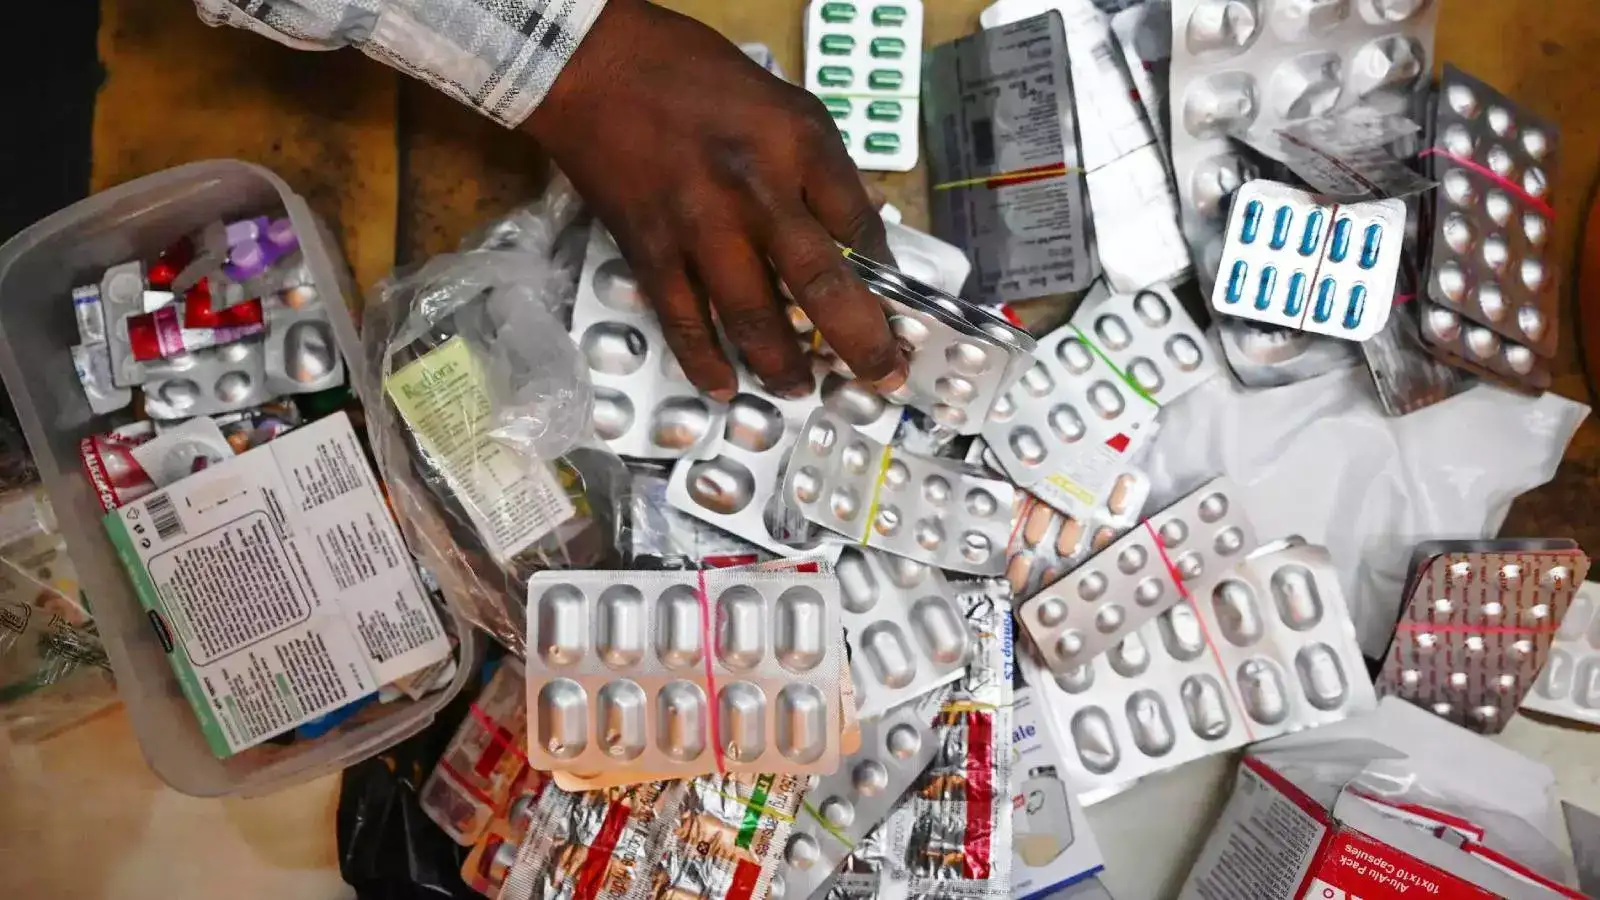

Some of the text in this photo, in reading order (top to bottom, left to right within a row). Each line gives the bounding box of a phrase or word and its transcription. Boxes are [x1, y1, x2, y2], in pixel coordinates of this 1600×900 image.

[1339, 854, 1410, 894] Alu-Alu Pack
[1344, 844, 1440, 895] 10x1x10 Capsules
